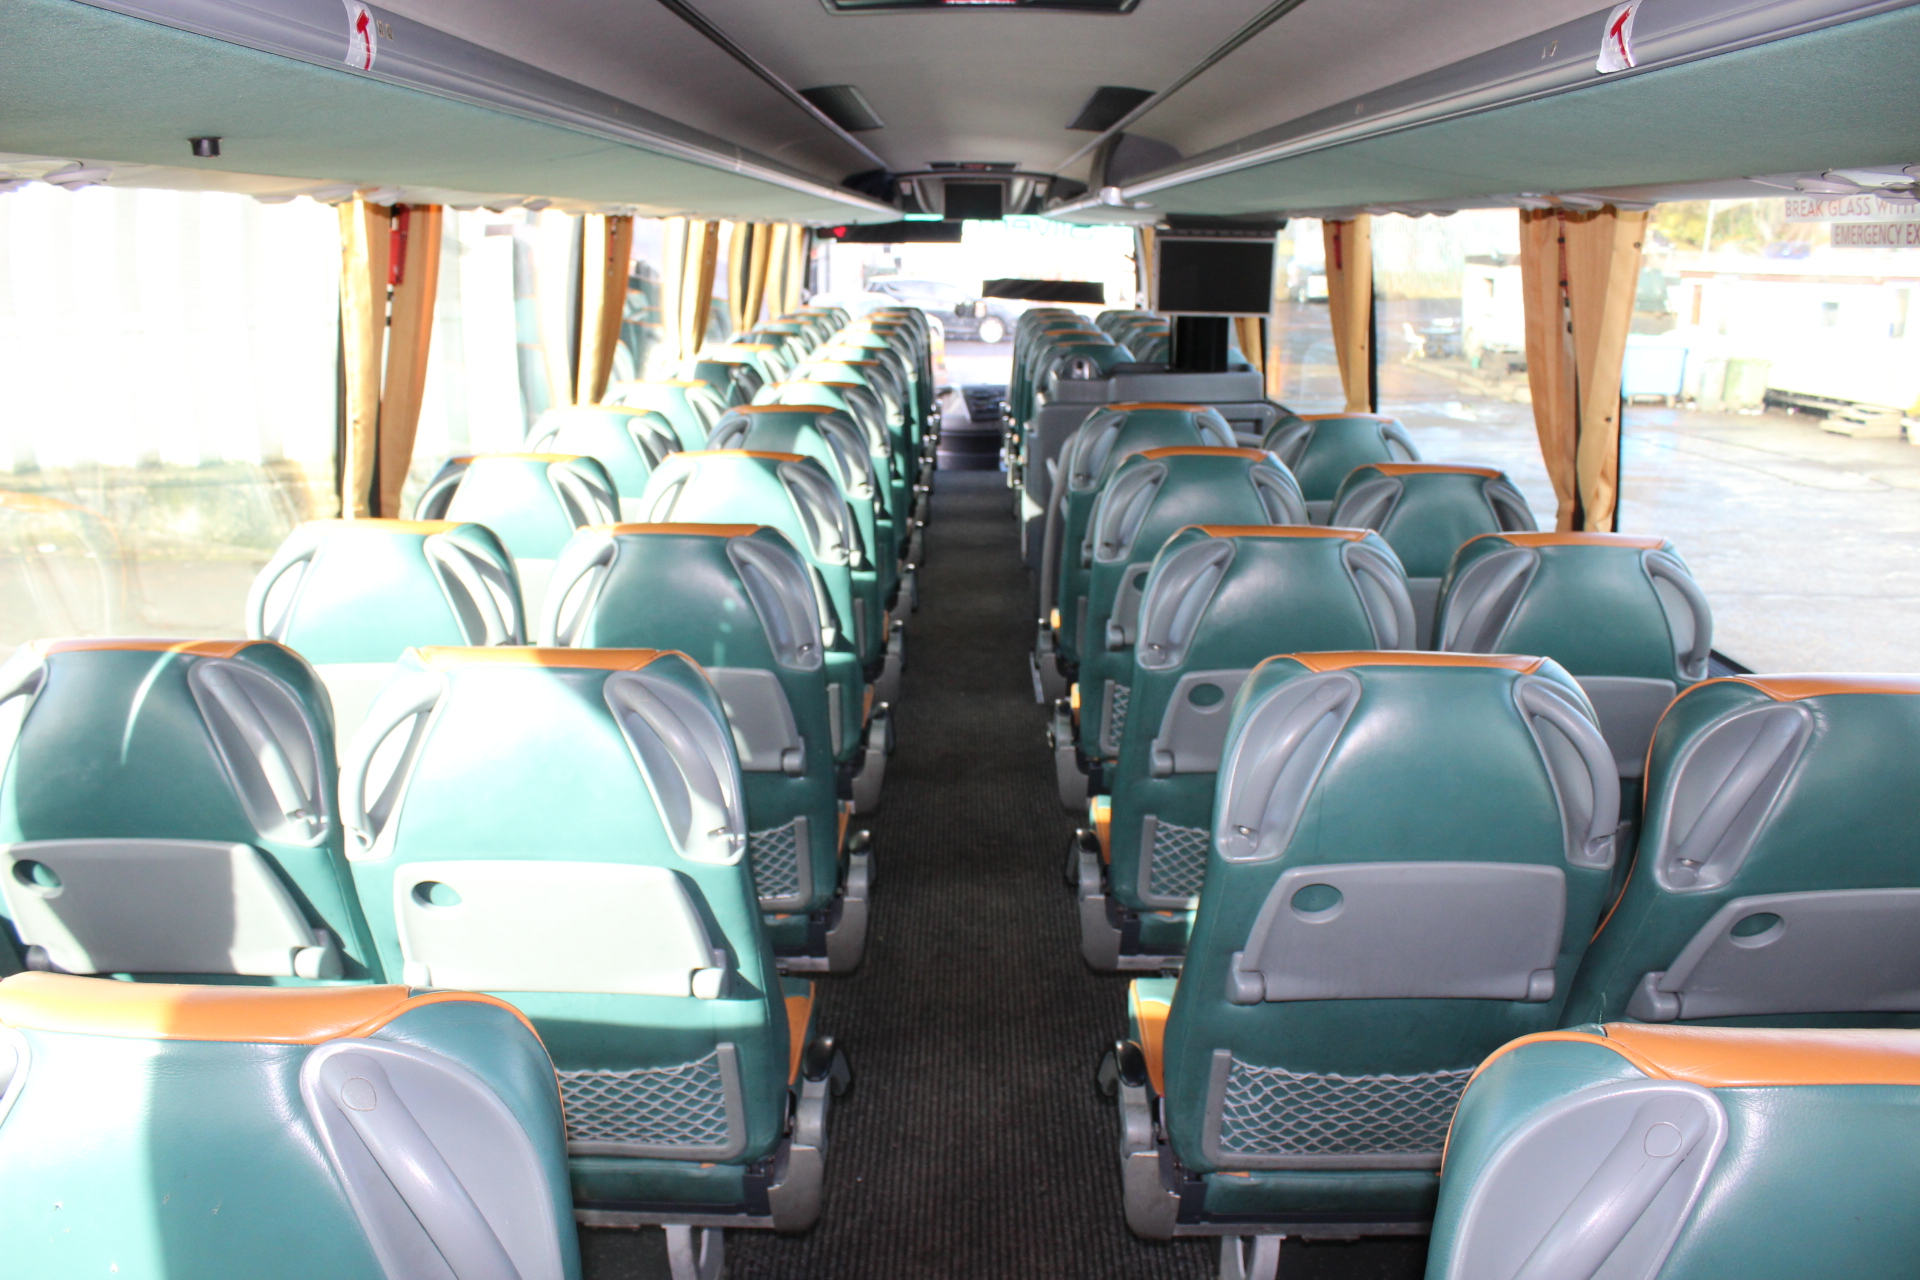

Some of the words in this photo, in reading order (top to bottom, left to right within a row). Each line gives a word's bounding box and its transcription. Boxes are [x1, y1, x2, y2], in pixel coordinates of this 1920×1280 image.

[1785, 200, 1824, 217] BREAK
[1828, 198, 1870, 216] GLASS
[1835, 224, 1902, 245] EMERGENCY
